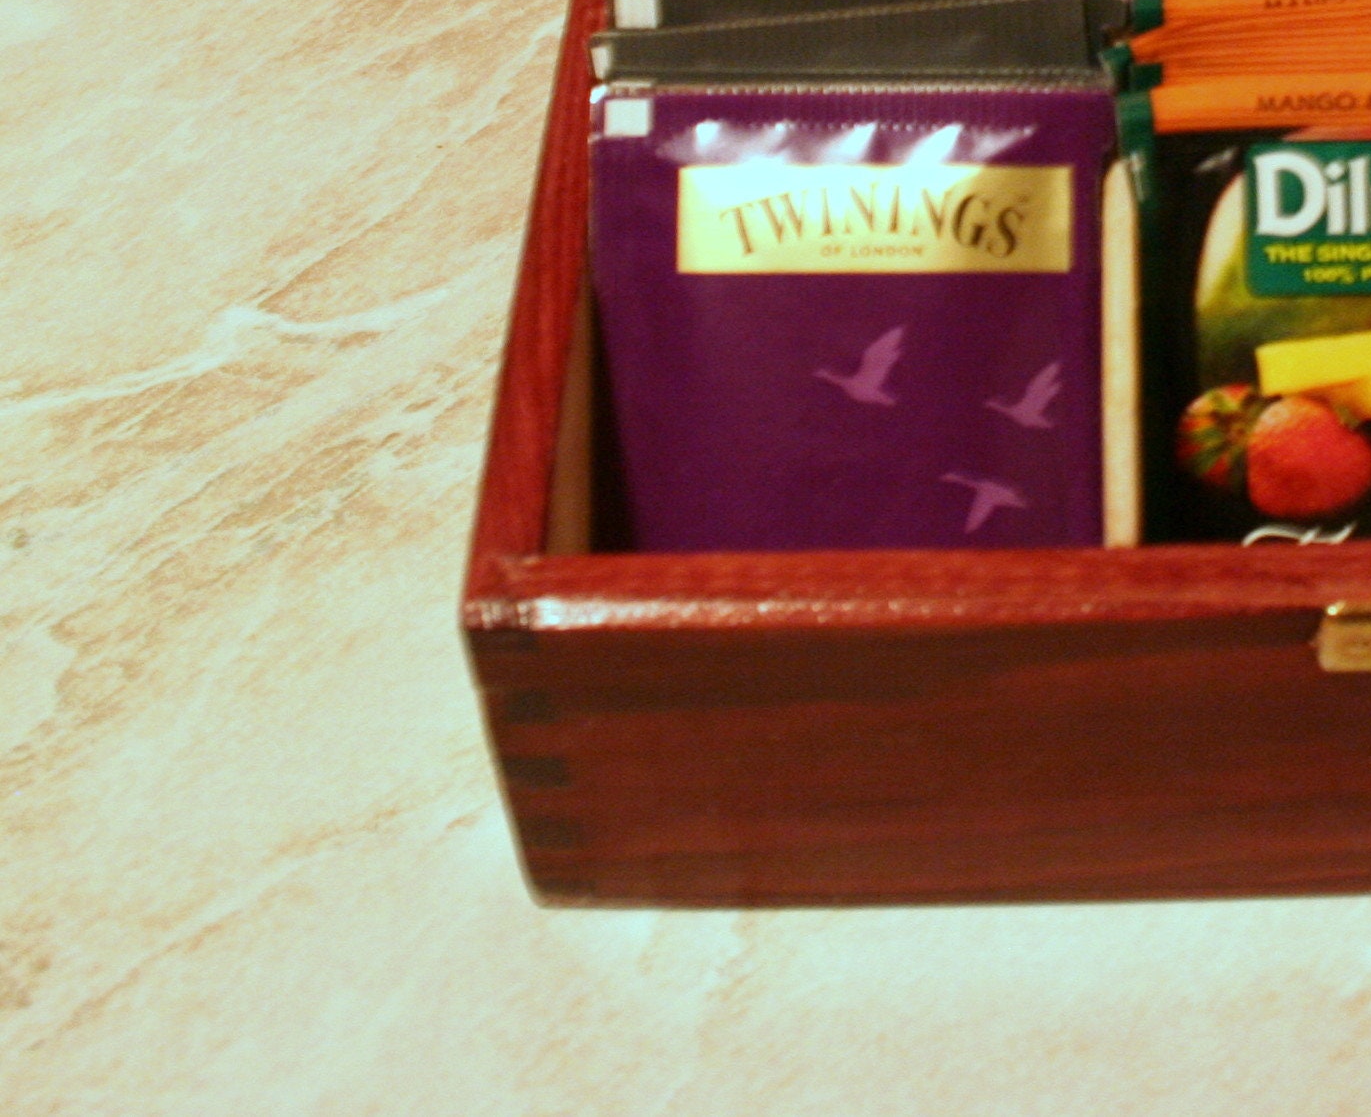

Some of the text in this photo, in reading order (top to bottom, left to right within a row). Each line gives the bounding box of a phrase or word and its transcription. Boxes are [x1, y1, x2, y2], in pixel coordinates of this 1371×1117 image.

[1257, 90, 1358, 113] MANGO
[719, 182, 1026, 259] TWININGS
[819, 244, 926, 258] OF LONDON
[1265, 243, 1314, 263] THE
